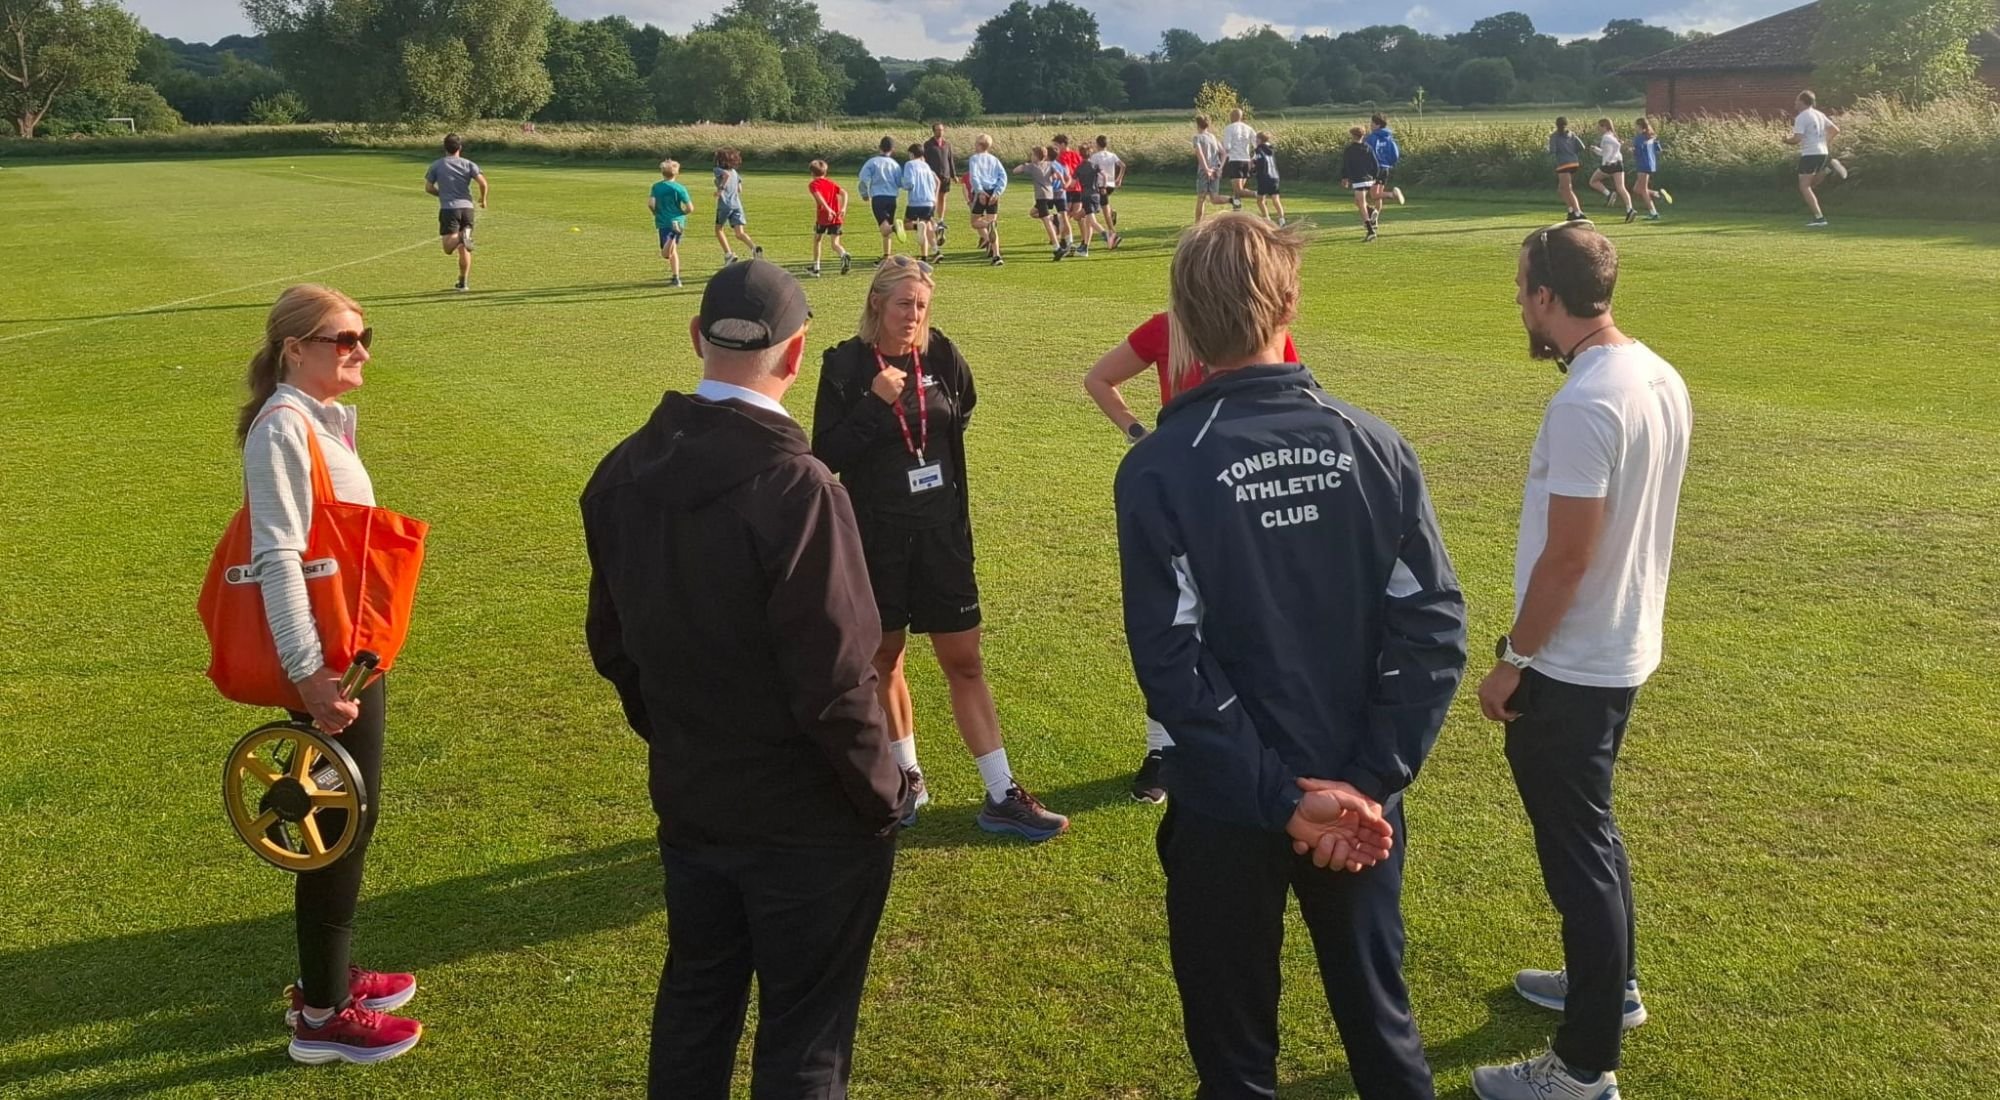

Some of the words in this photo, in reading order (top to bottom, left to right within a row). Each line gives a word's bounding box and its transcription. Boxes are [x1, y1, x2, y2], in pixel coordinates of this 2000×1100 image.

[1216, 447, 1353, 487] TONBRIDGE
[1235, 471, 1342, 502] ATHLETIC
[1260, 504, 1320, 528] CLUB
